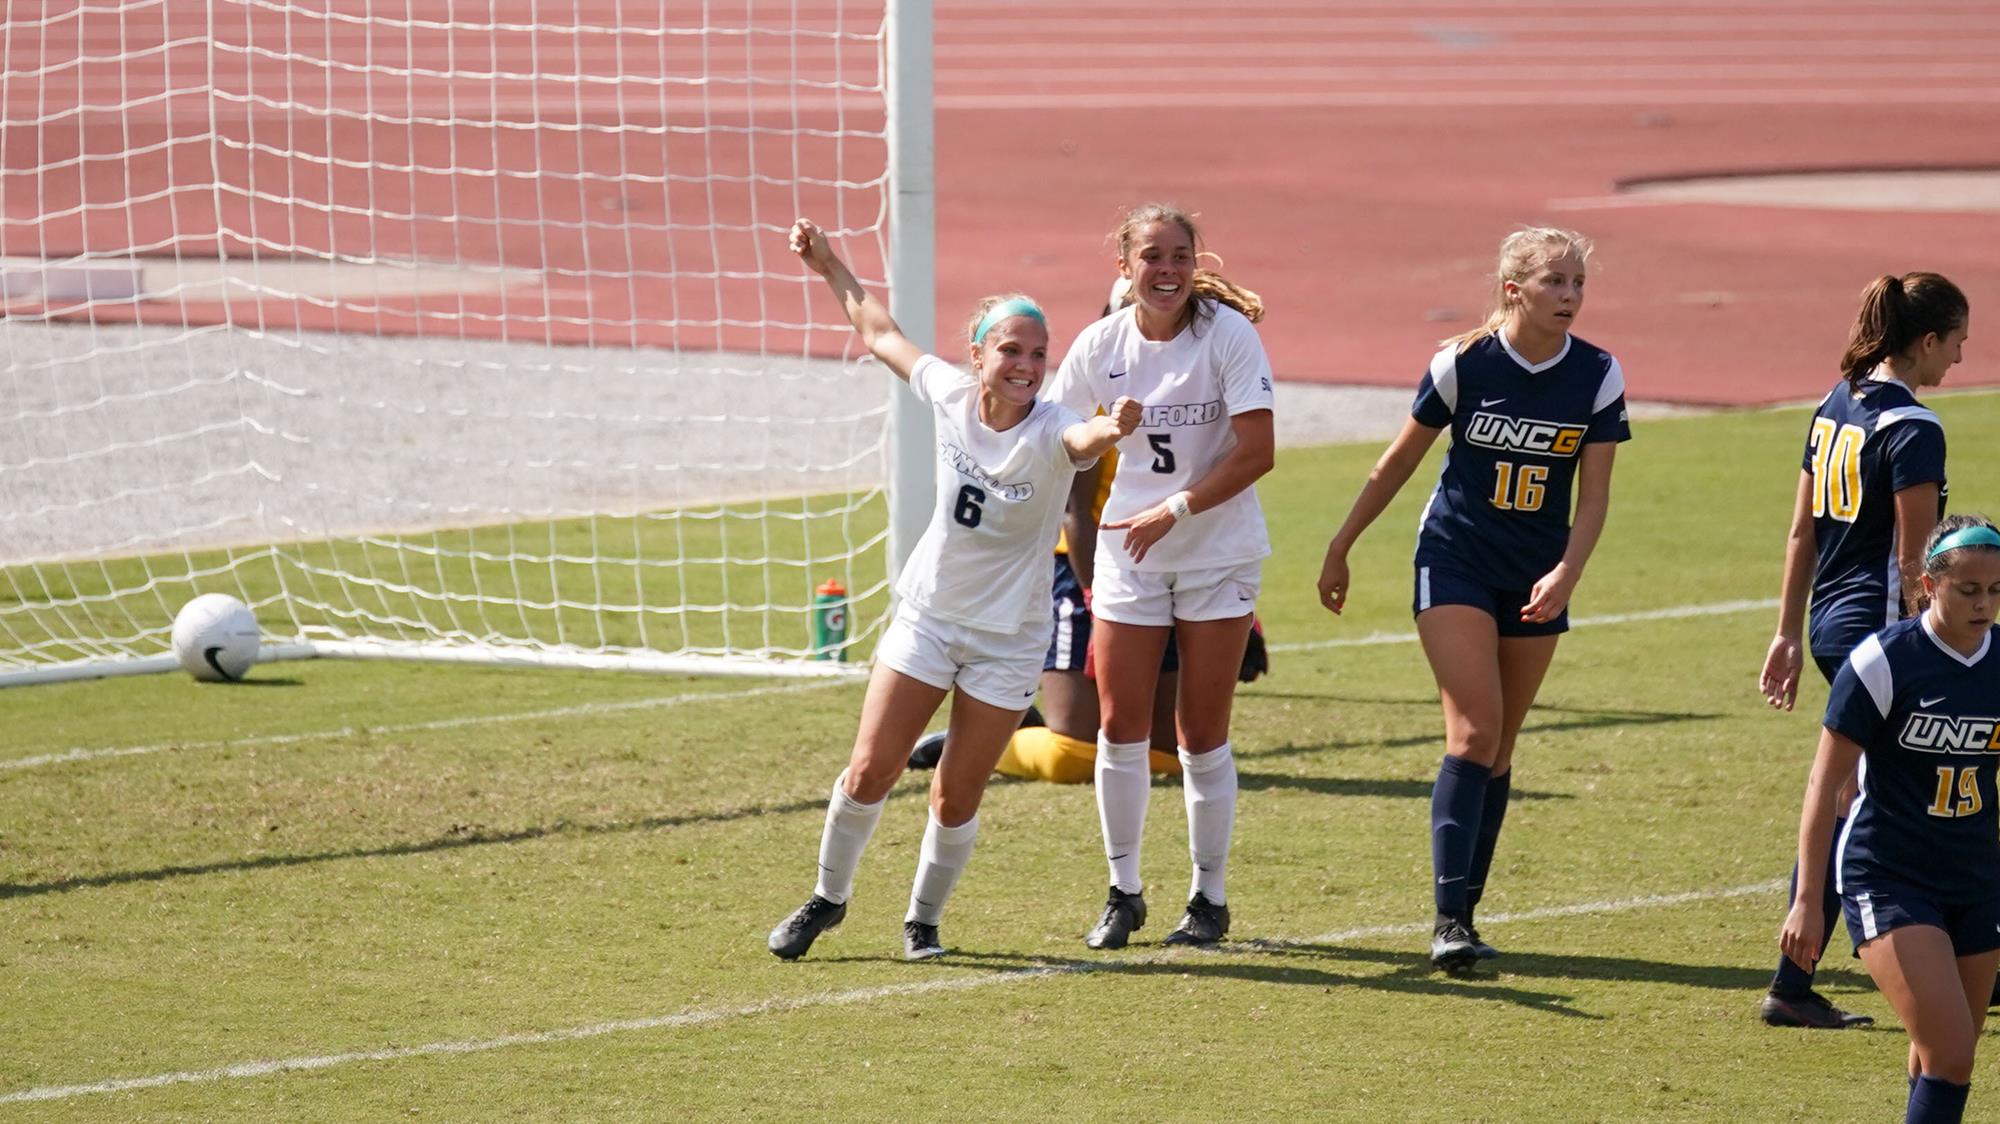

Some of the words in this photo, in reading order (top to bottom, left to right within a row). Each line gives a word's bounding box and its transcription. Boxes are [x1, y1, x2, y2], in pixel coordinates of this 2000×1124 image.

[1147, 433, 1176, 474] 5
[1466, 412, 1588, 457] UNCG
[1489, 461, 1549, 512] 16
[1811, 416, 1866, 523] 30
[954, 484, 986, 529] 6
[1927, 765, 1983, 818] 19
